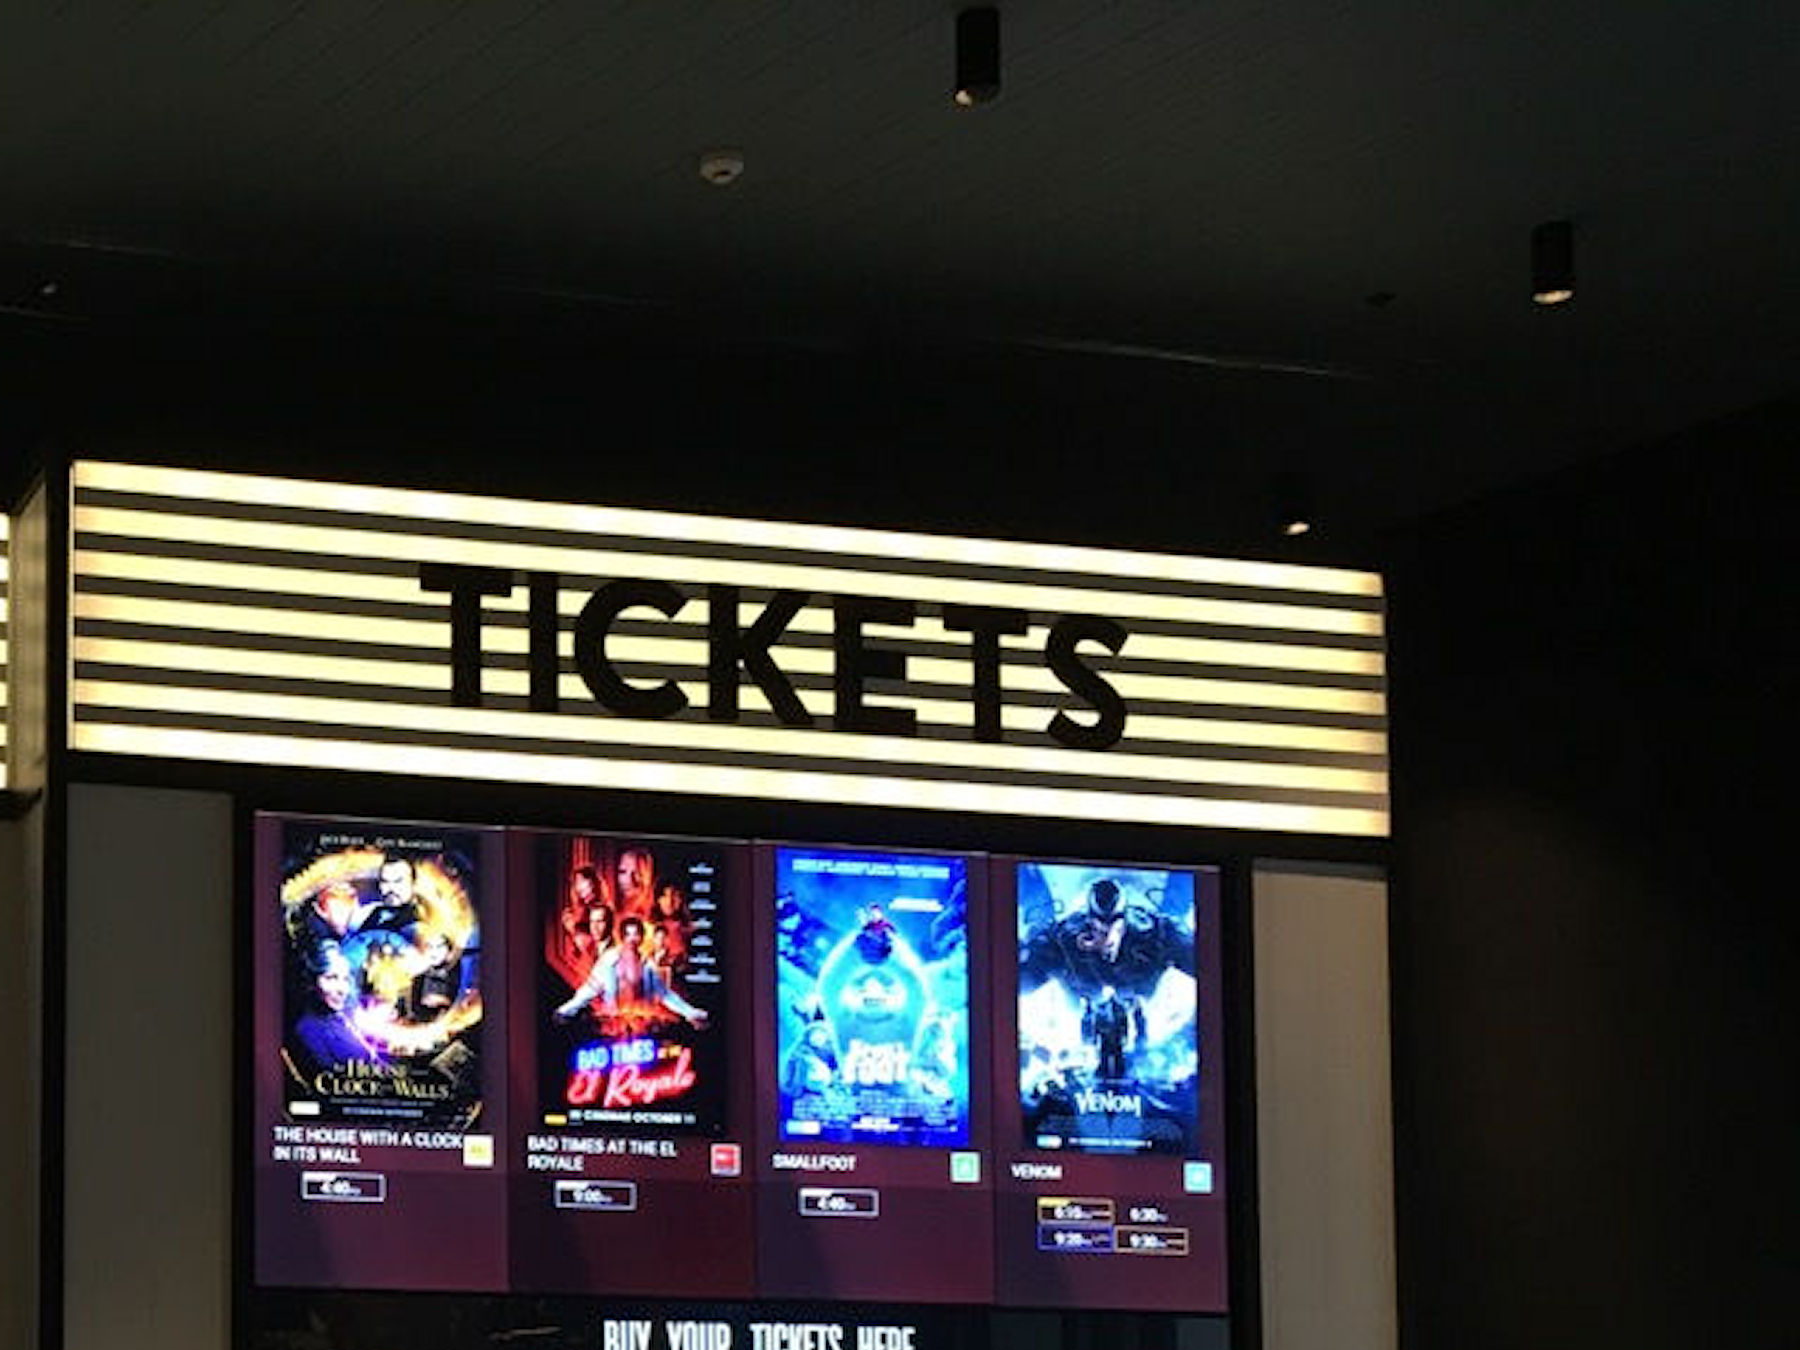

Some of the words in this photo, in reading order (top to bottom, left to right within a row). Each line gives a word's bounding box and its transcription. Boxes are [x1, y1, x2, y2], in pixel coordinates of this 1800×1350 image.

[420, 562, 1129, 751] TICKETS
[577, 1047, 610, 1071] BAD
[612, 1038, 655, 1063] TIMES
[1074, 1088, 1141, 1118] VENOM
[274, 1126, 304, 1143] THE
[306, 1128, 357, 1145] HOUSE
[360, 1130, 398, 1147] WITH
[400, 1132, 413, 1147] A
[414, 1133, 463, 1149] CLOCK
[527, 1135, 558, 1152] BAD
[561, 1137, 605, 1154] TIMES
[606, 1138, 626, 1155] AT
[629, 1139, 657, 1156] THE
[659, 1140, 677, 1157] EL
[274, 1146, 291, 1161] IN
[292, 1146, 317, 1162] ITS
[319, 1148, 361, 1163] WALL
[527, 1154, 584, 1171] ROYALE
[772, 1154, 857, 1172] SMALLFOOT
[1011, 1163, 1063, 1180] VENOM
